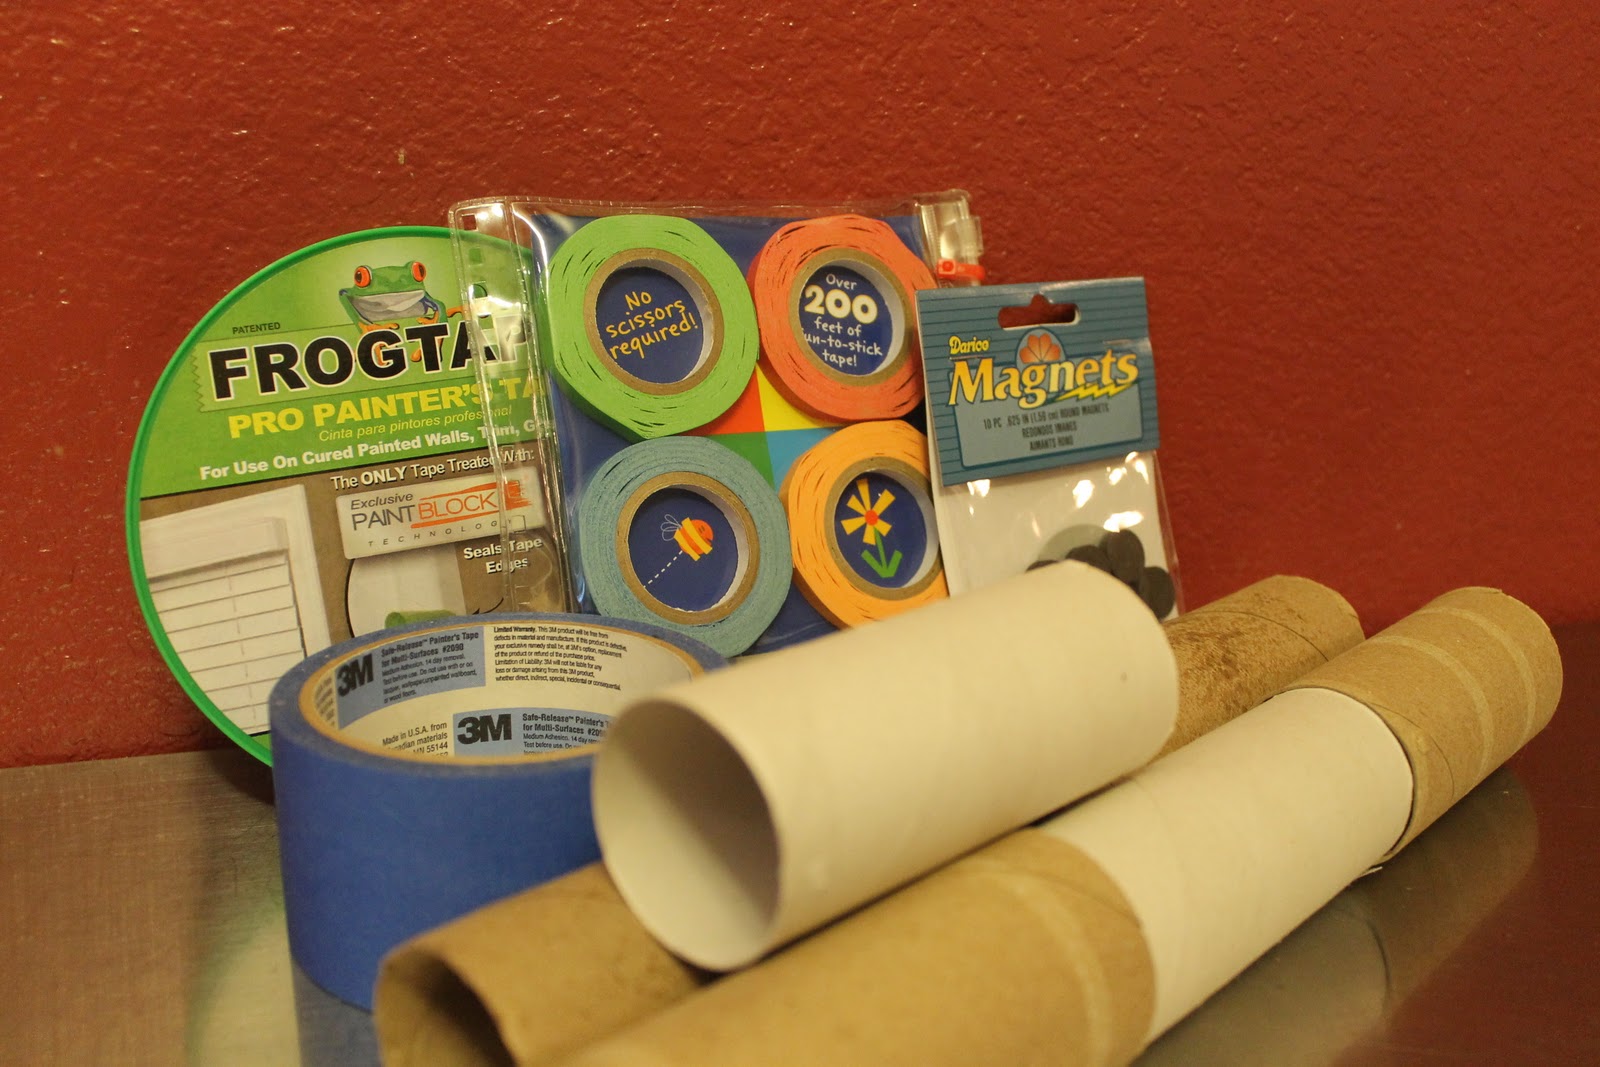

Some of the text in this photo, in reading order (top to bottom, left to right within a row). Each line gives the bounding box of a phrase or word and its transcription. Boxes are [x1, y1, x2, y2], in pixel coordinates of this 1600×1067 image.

[826, 273, 857, 290] Over
[624, 290, 652, 310] No
[804, 284, 878, 324] 200
[232, 322, 281, 334] PATENTED
[606, 299, 686, 338] scissors
[814, 316, 862, 337] feet of
[609, 312, 698, 359] required!
[802, 330, 883, 356] un-to-stick
[208, 314, 529, 401] FROGTAP
[822, 348, 858, 368] tape!
[947, 349, 1139, 409] Magnets
[228, 407, 304, 439] PRO
[313, 381, 493, 427] PAINTER'S
[499, 377, 545, 401] TA
[319, 404, 512, 442] Cinta para pintores profesnal
[984, 419, 992, 430] 10
[994, 417, 1002, 428] PC
[200, 465, 230, 480] For
[233, 459, 269, 477] Use
[273, 454, 298, 470] On
[302, 446, 354, 466] Cured
[358, 437, 422, 458] Painted
[425, 430, 475, 447] Walls,
[477, 424, 519, 440] Tim,
[330, 475, 359, 491] The
[360, 466, 407, 487] ONLY
[410, 462, 446, 479] Tape
[350, 492, 414, 511] Exclusive
[463, 537, 544, 560] Seals Tape
[430, 631, 480, 645] Painter's Tape
[432, 656, 442, 664] day
[337, 653, 374, 697] 3M
[457, 713, 512, 745] 3M
[534, 724, 584, 734] Multi-Surfaces
[588, 728, 602, 738] #20
[576, 716, 604, 728] Painter's
[382, 722, 448, 746] Made in U.S.A. from
[416, 732, 448, 746] materials
[578, 736, 588, 744] day
[426, 741, 448, 754] 55144
